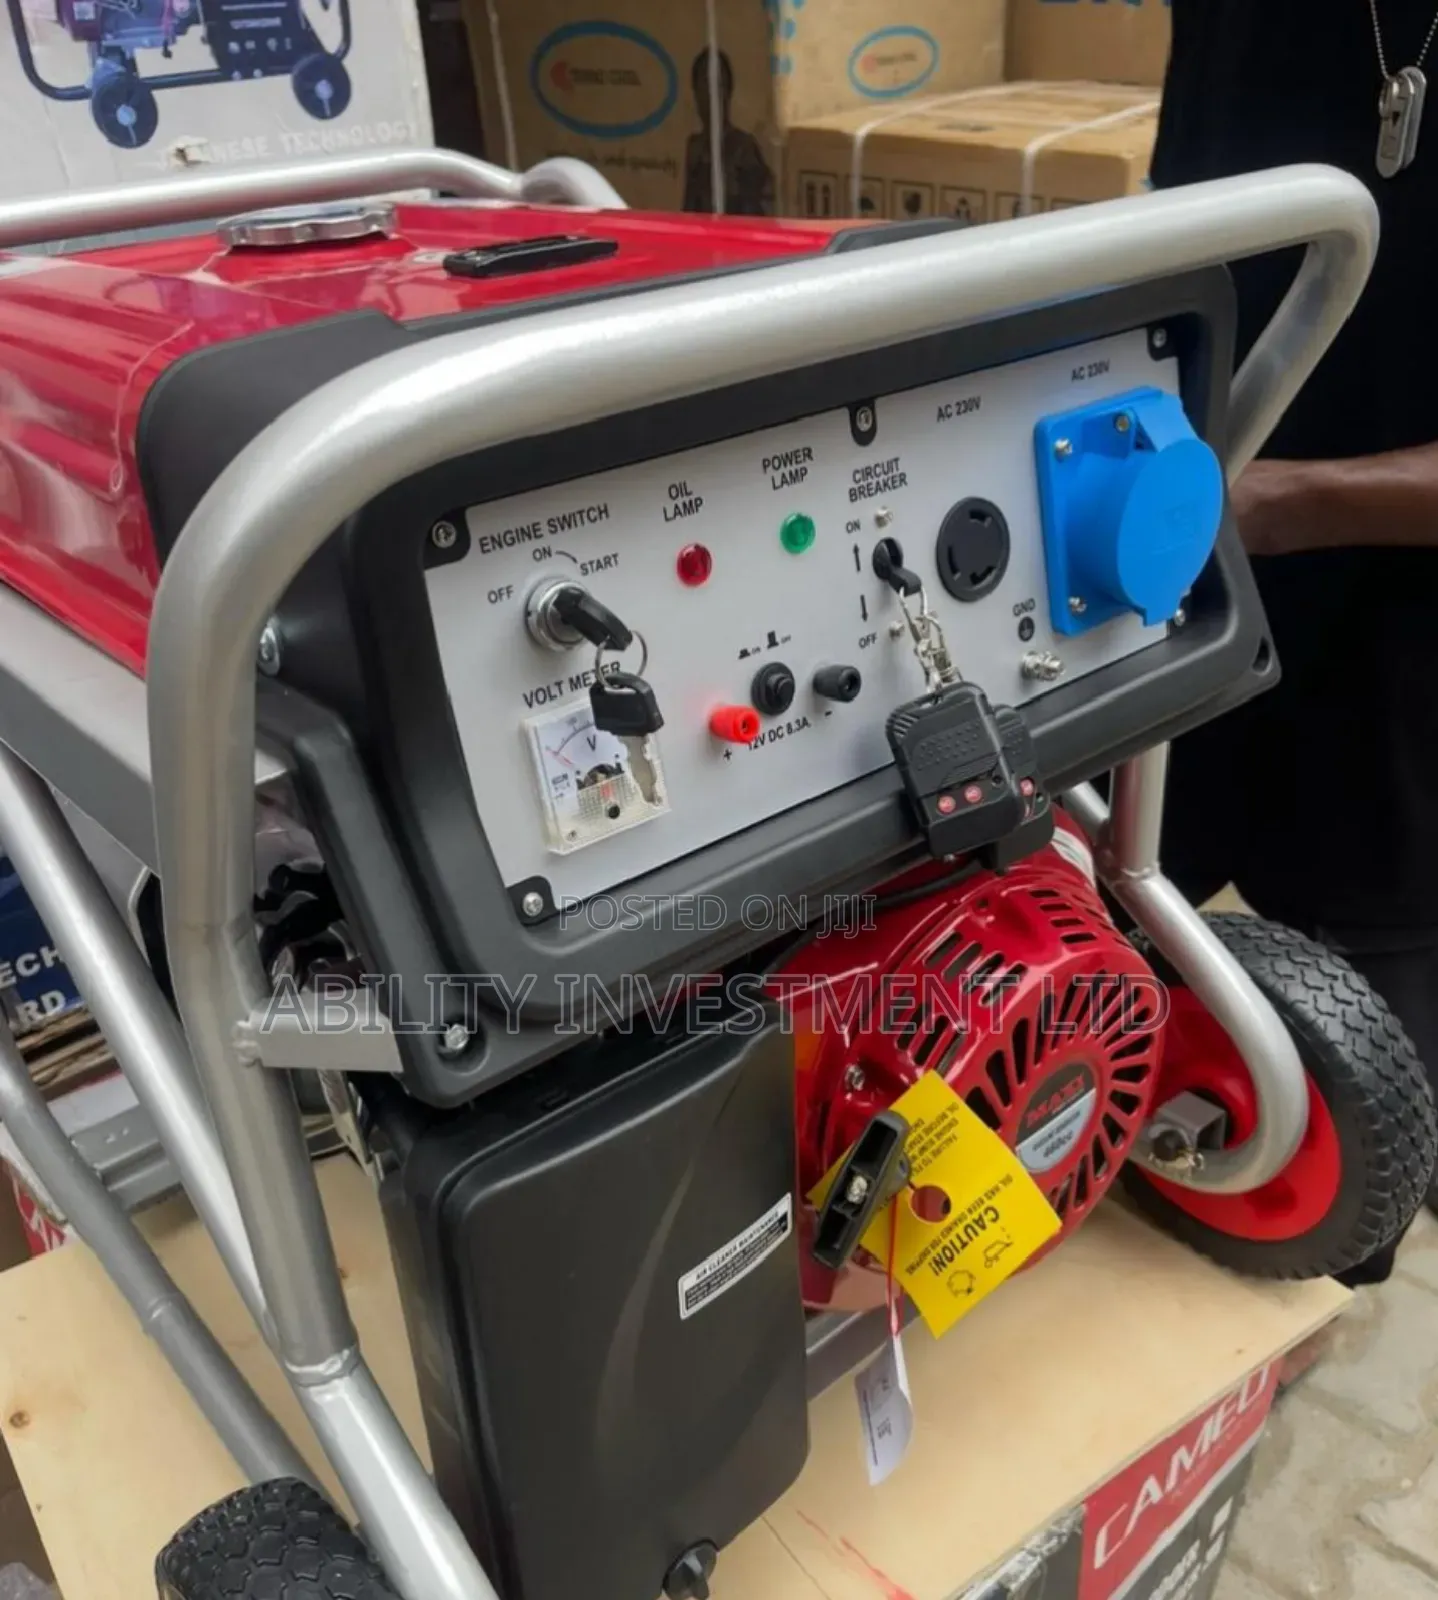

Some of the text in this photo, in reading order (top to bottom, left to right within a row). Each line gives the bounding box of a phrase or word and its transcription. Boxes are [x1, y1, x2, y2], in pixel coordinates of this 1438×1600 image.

[1071, 359, 1110, 382] AC 230V
[937, 396, 982, 423] AC 230V
[762, 447, 814, 474] POWER
[852, 457, 901, 484] CIRCUIT
[771, 466, 808, 490] LAMP
[848, 471, 908, 502] BREAKER
[668, 480, 693, 501] OIL
[663, 497, 703, 522] LAMP
[479, 502, 610, 554] ENGINE SWITCH
[845, 518, 861, 534] ON
[532, 545, 553, 562] ON
[580, 552, 620, 577] START
[487, 585, 514, 604] OFF
[1012, 599, 1036, 617] GND
[858, 632, 877, 649] OFF
[522, 680, 564, 709] VOLT
[586, 734, 597, 752] V
[768, 725, 785, 743] DC
[9, 989, 66, 1030] RD
[928, 1205, 1000, 1277] CAUTION!
